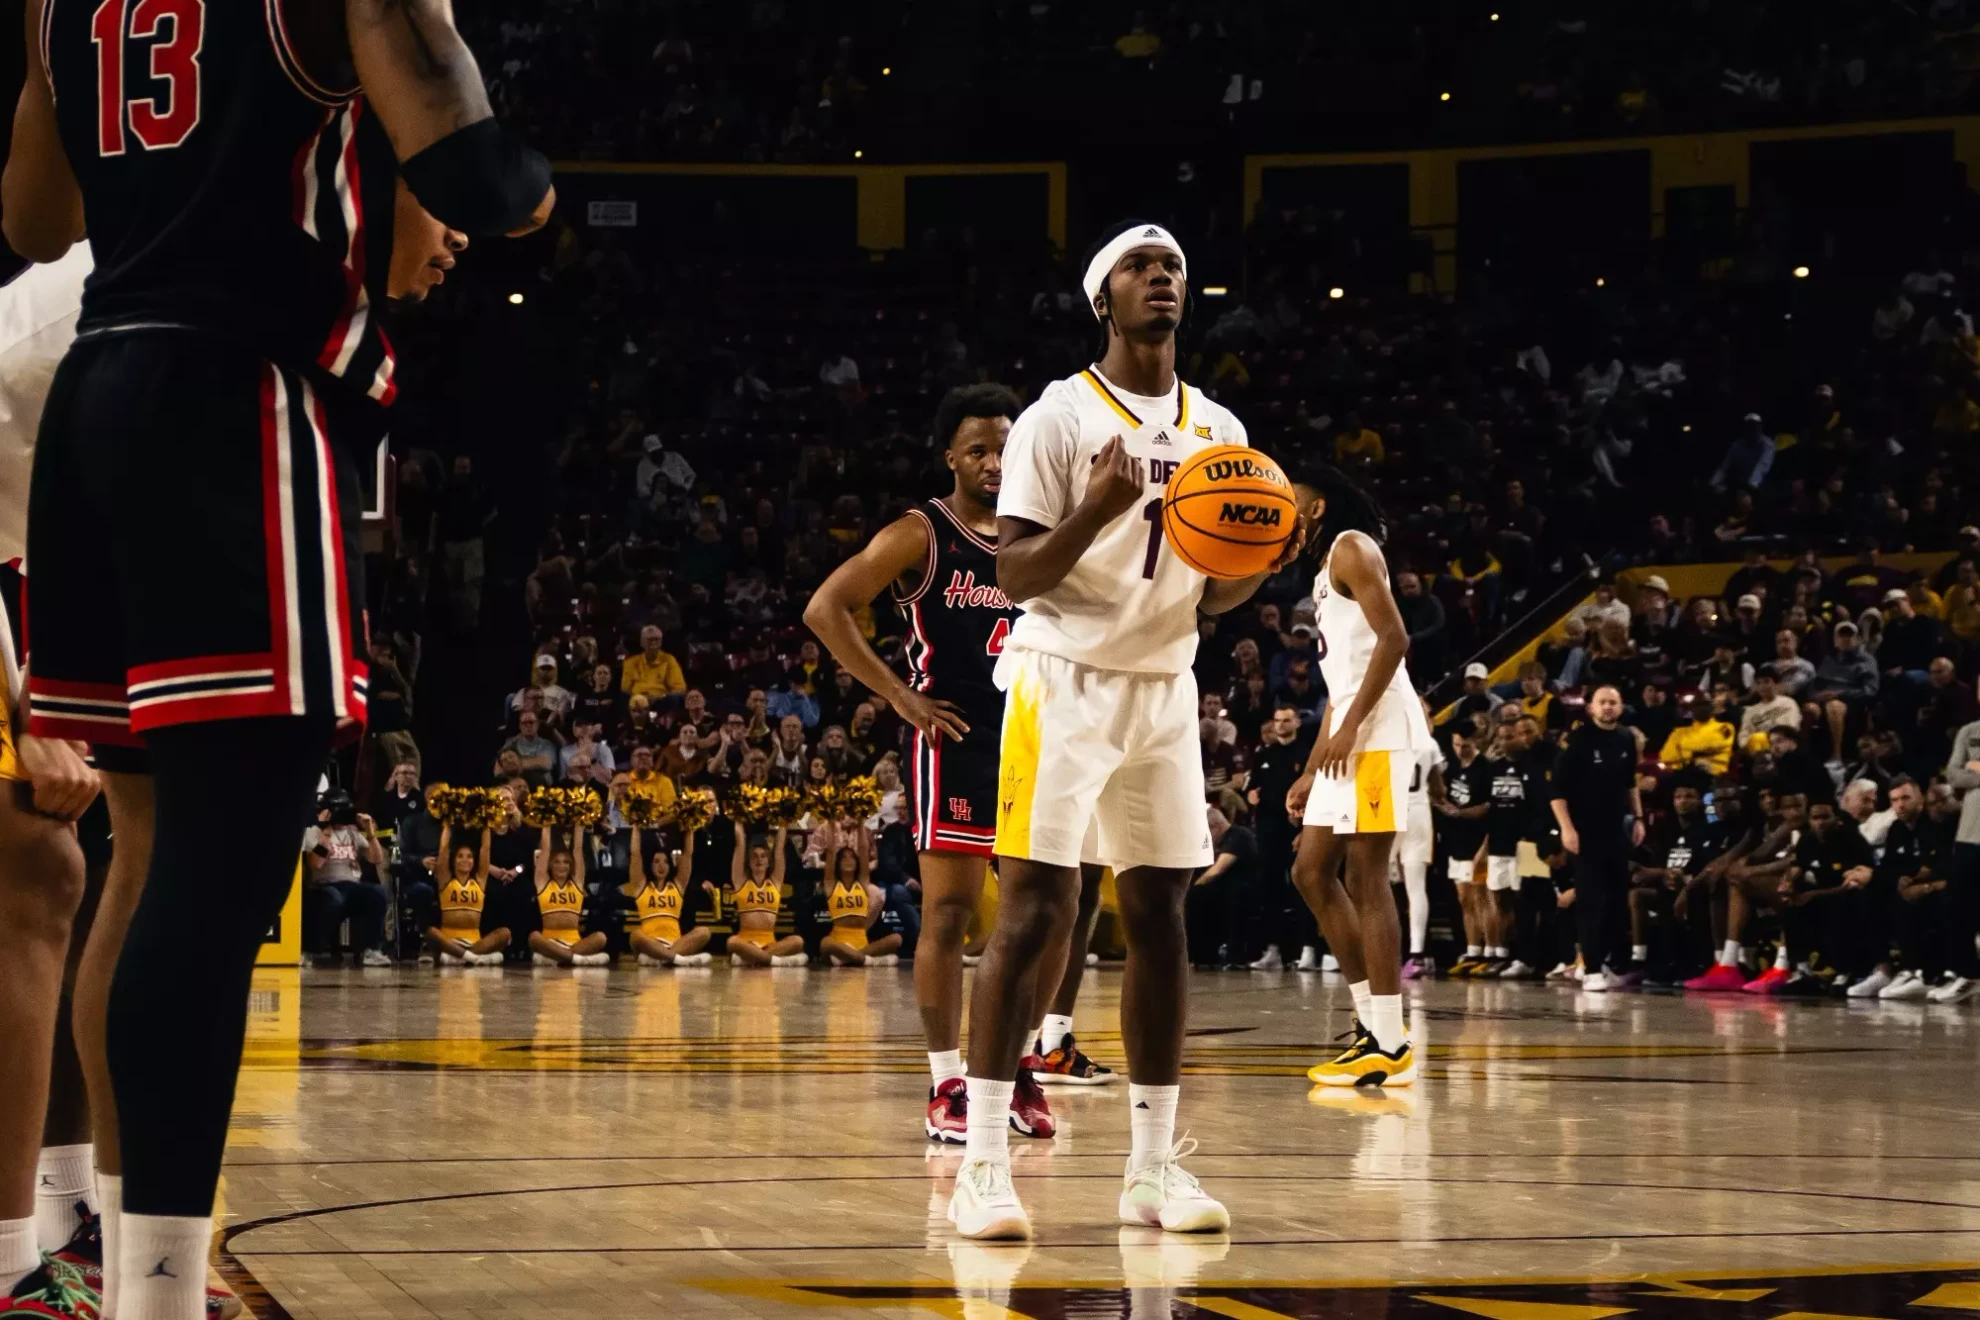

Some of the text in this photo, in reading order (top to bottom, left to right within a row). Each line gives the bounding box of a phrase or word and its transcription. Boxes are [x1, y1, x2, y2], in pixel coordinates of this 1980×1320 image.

[91, 0, 205, 157] 13
[1203, 459, 1288, 489] Wilson
[1219, 503, 1281, 526] NCAA
[1142, 497, 1164, 580] 1
[943, 569, 1014, 610] Hous
[949, 797, 972, 821] UH
[450, 890, 479, 903] ASU
[548, 892, 577, 904] ASU
[647, 895, 676, 908] ASU
[746, 891, 774, 904] ASU
[836, 896, 863, 909] ASU
